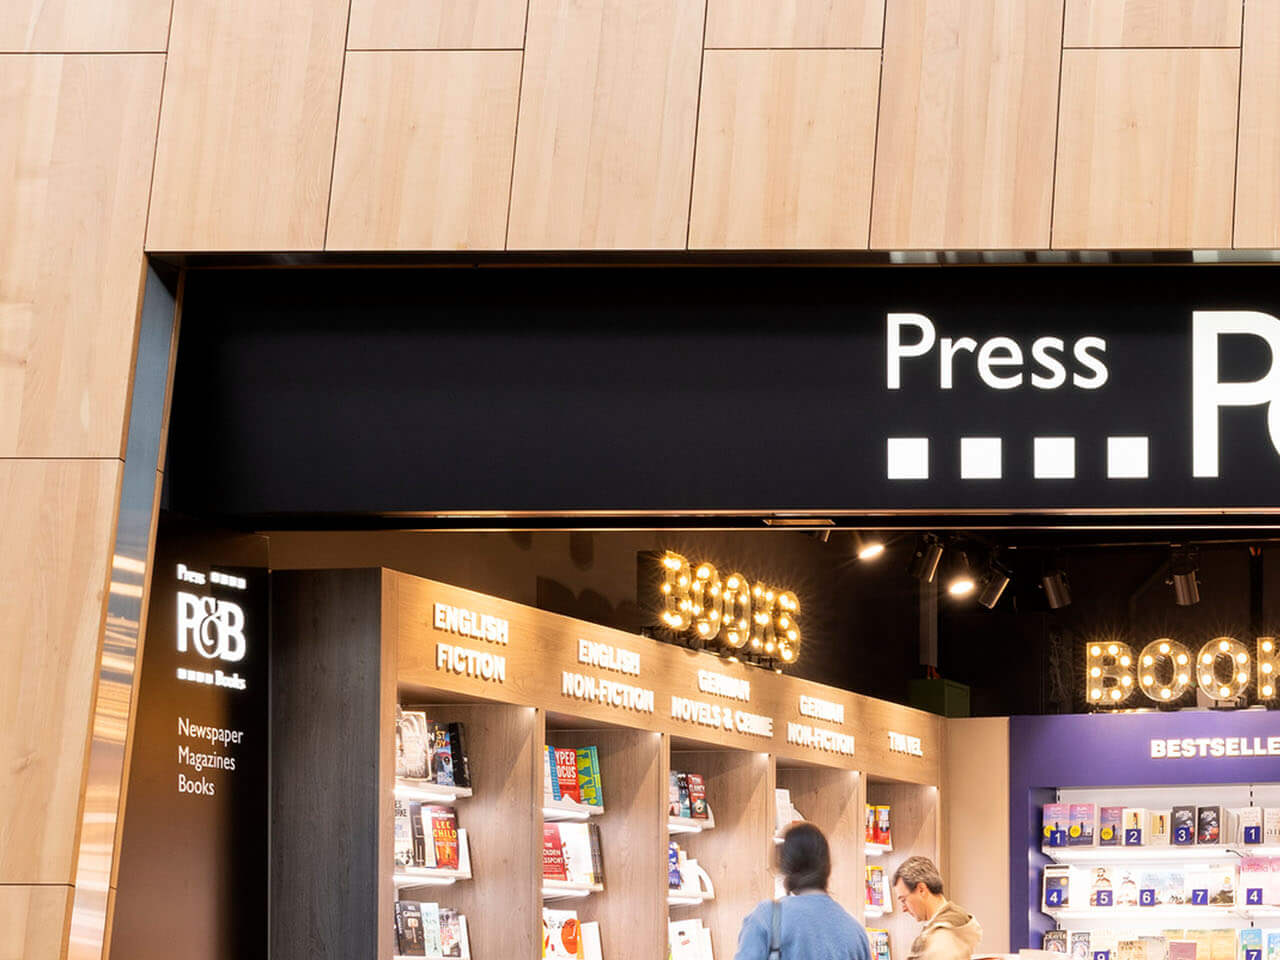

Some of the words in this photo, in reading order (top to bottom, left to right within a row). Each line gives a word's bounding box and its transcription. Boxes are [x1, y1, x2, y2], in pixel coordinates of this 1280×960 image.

[887, 312, 1108, 390] Press
[176, 563, 206, 585] Press
[434, 602, 509, 645] ENGLISH
[661, 550, 801, 664] BOOKS
[176, 590, 247, 663] P&B
[436, 642, 506, 683] FICTION
[578, 639, 640, 675] ENGLISH
[214, 670, 247, 690] Books
[562, 672, 654, 712] NON-FICTION
[178, 717, 244, 746] Newspaper
[671, 696, 721, 729] NOVELS
[722, 706, 734, 731] &
[735, 710, 774, 738] CRIME
[787, 722, 855, 756] NON-FICTION
[888, 731, 924, 757] TRAVEL
[178, 746, 236, 771] Magazines
[555, 751, 575, 766] YPER
[178, 774, 215, 796] Books
